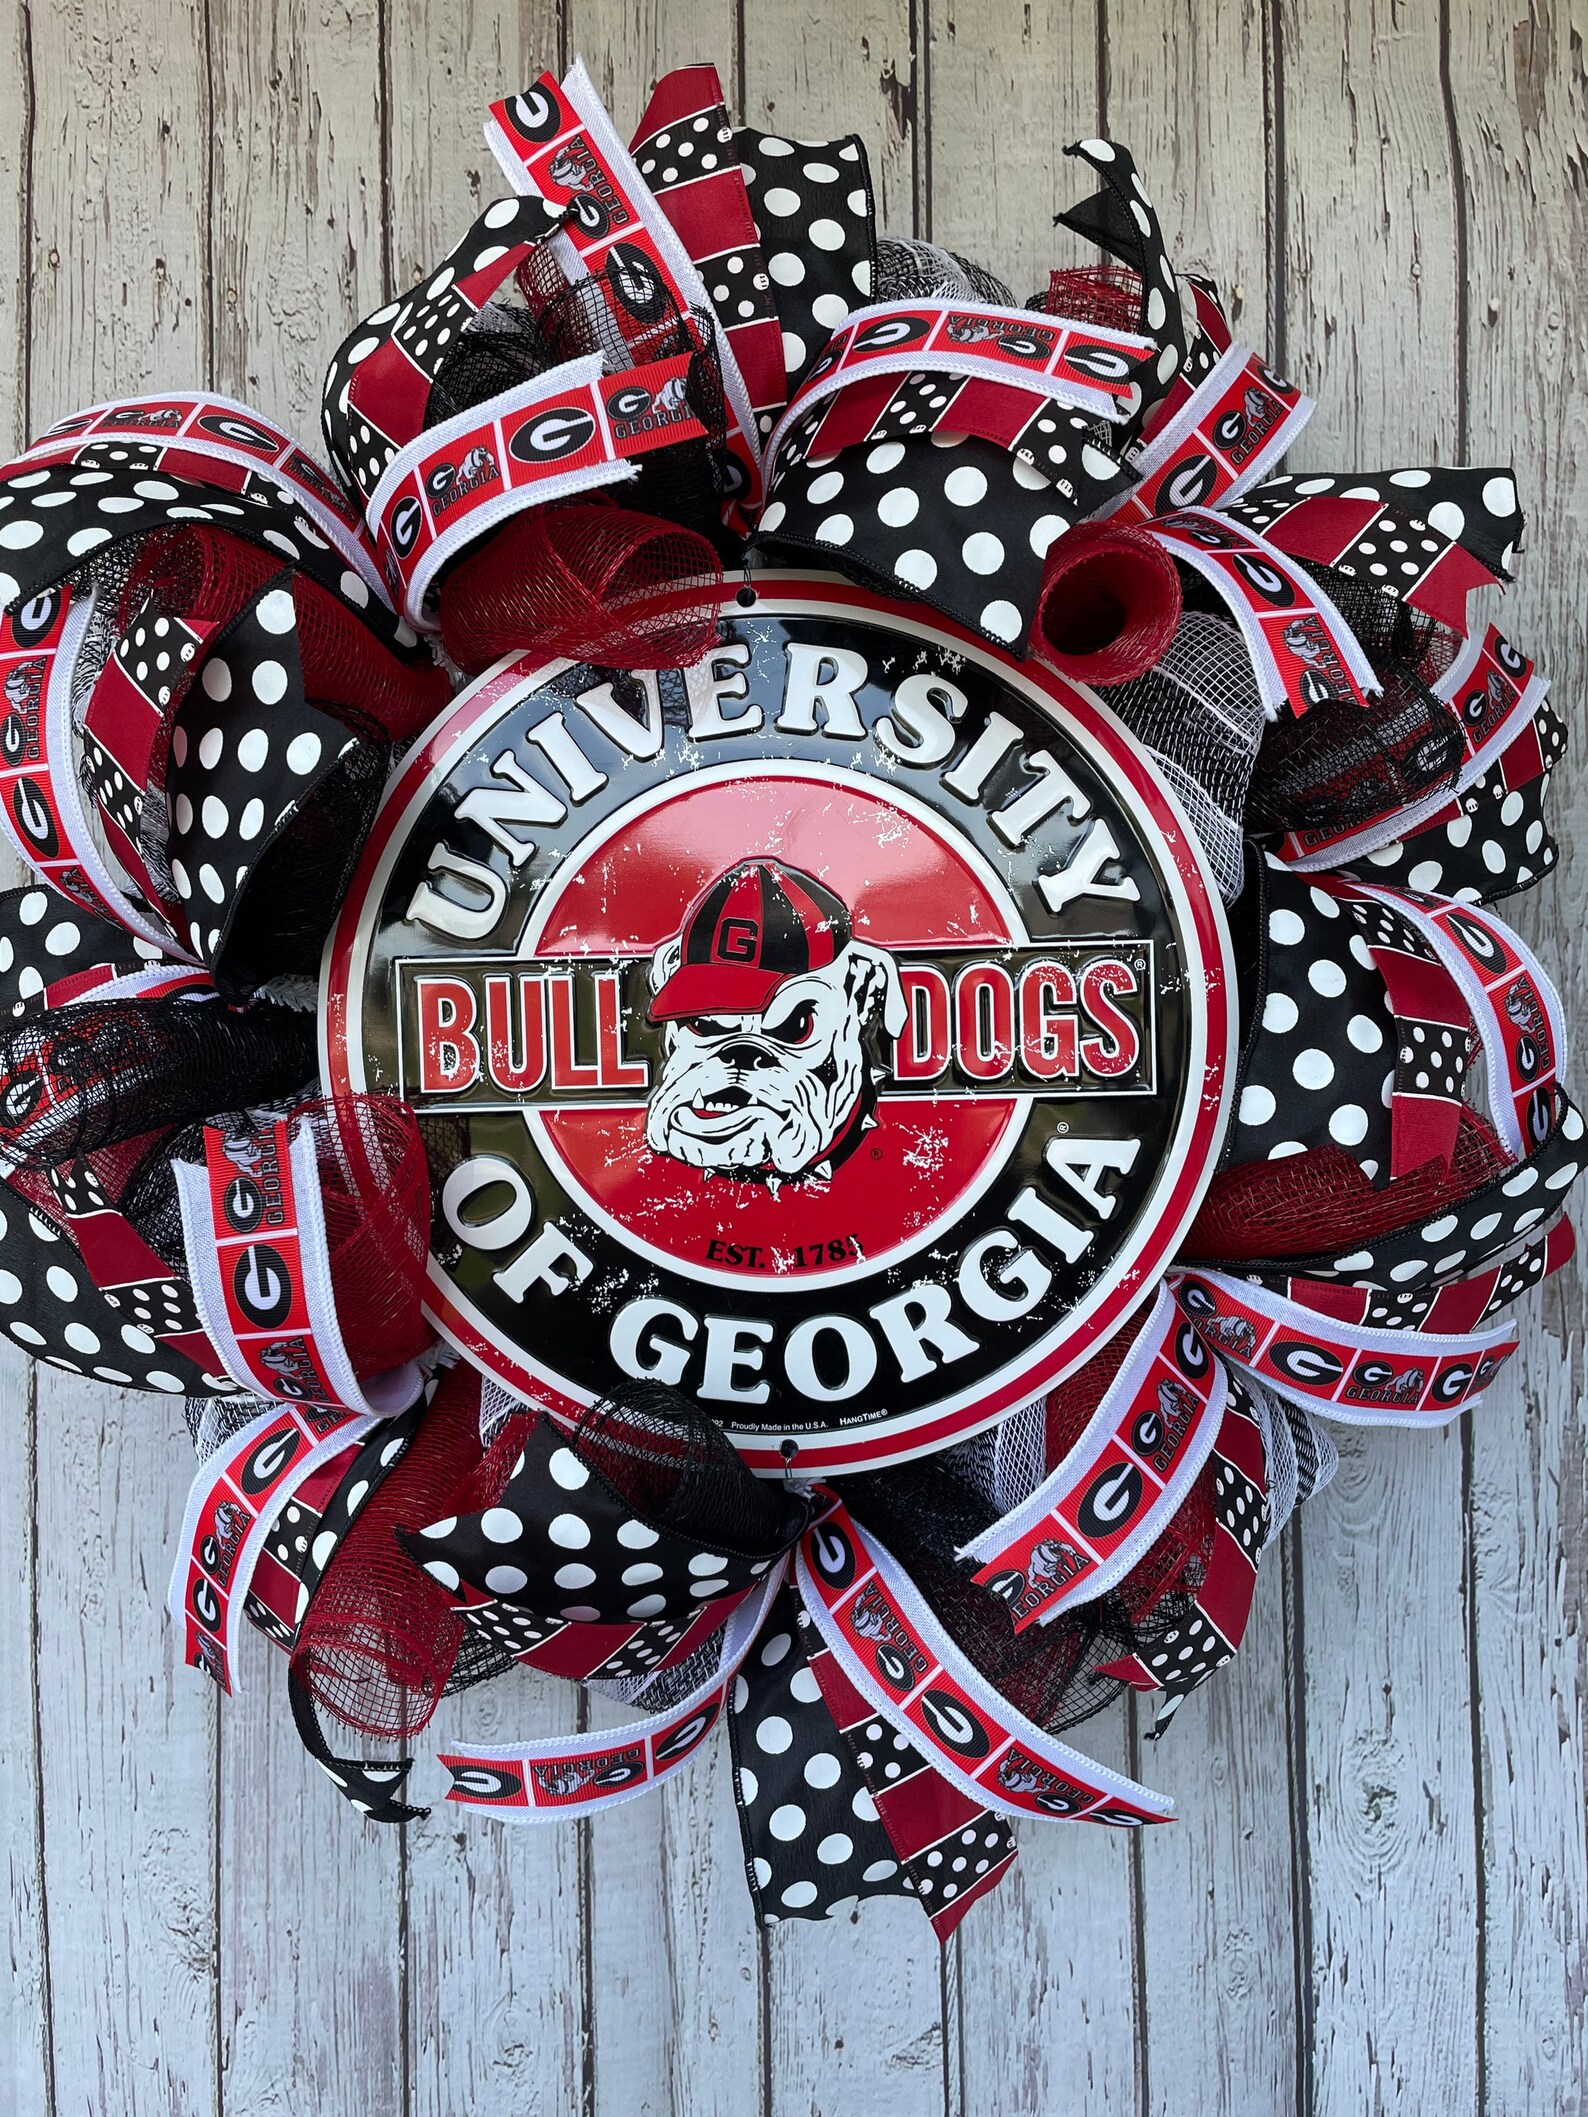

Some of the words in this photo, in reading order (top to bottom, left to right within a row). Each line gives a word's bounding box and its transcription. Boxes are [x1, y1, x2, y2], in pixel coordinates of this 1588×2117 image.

[568, 134, 630, 225] GEORGIA
[530, 414, 593, 452] G
[615, 405, 692, 438] GEORGI
[1231, 400, 1284, 465] GEORGIA
[431, 464, 501, 517] GEORGIA
[1168, 454, 1212, 508] G
[26, 656, 47, 761] GEORGIA
[1472, 687, 1518, 745] GEORGIA
[405, 642, 1141, 940] UNIVERSITY
[716, 916, 760, 964] G
[416, 973, 650, 1094] BULL
[1517, 975, 1553, 1071] GEORGIA
[258, 1127, 284, 1226] GEORGI
[244, 1244, 282, 1311] G
[441, 1153, 595, 1305] OF
[609, 1136, 1141, 1405] GEORGIA
[705, 1238, 767, 1269] EST.
[793, 1232, 865, 1269] 1785
[1344, 1385, 1420, 1405] GEORGIA
[253, 1428, 299, 1480] G
[731, 1421, 760, 1432] Proudly
[761, 1423, 782, 1431] Made
[783, 1423, 790, 1431] in
[791, 1422, 804, 1431] the
[805, 1420, 829, 1431] U.S.A.
[1153, 1390, 1200, 1473] GEORGIA
[1092, 1462, 1136, 1522] G
[216, 1511, 252, 1590] GEORGIA
[1011, 1553, 1091, 1620] EORGIA
[861, 1579, 930, 1674] GEORGIA
[920, 1694, 974, 1744] G
[533, 1747, 640, 1777] GEORGIA
[1007, 1746, 1095, 1805] GEORGIA
